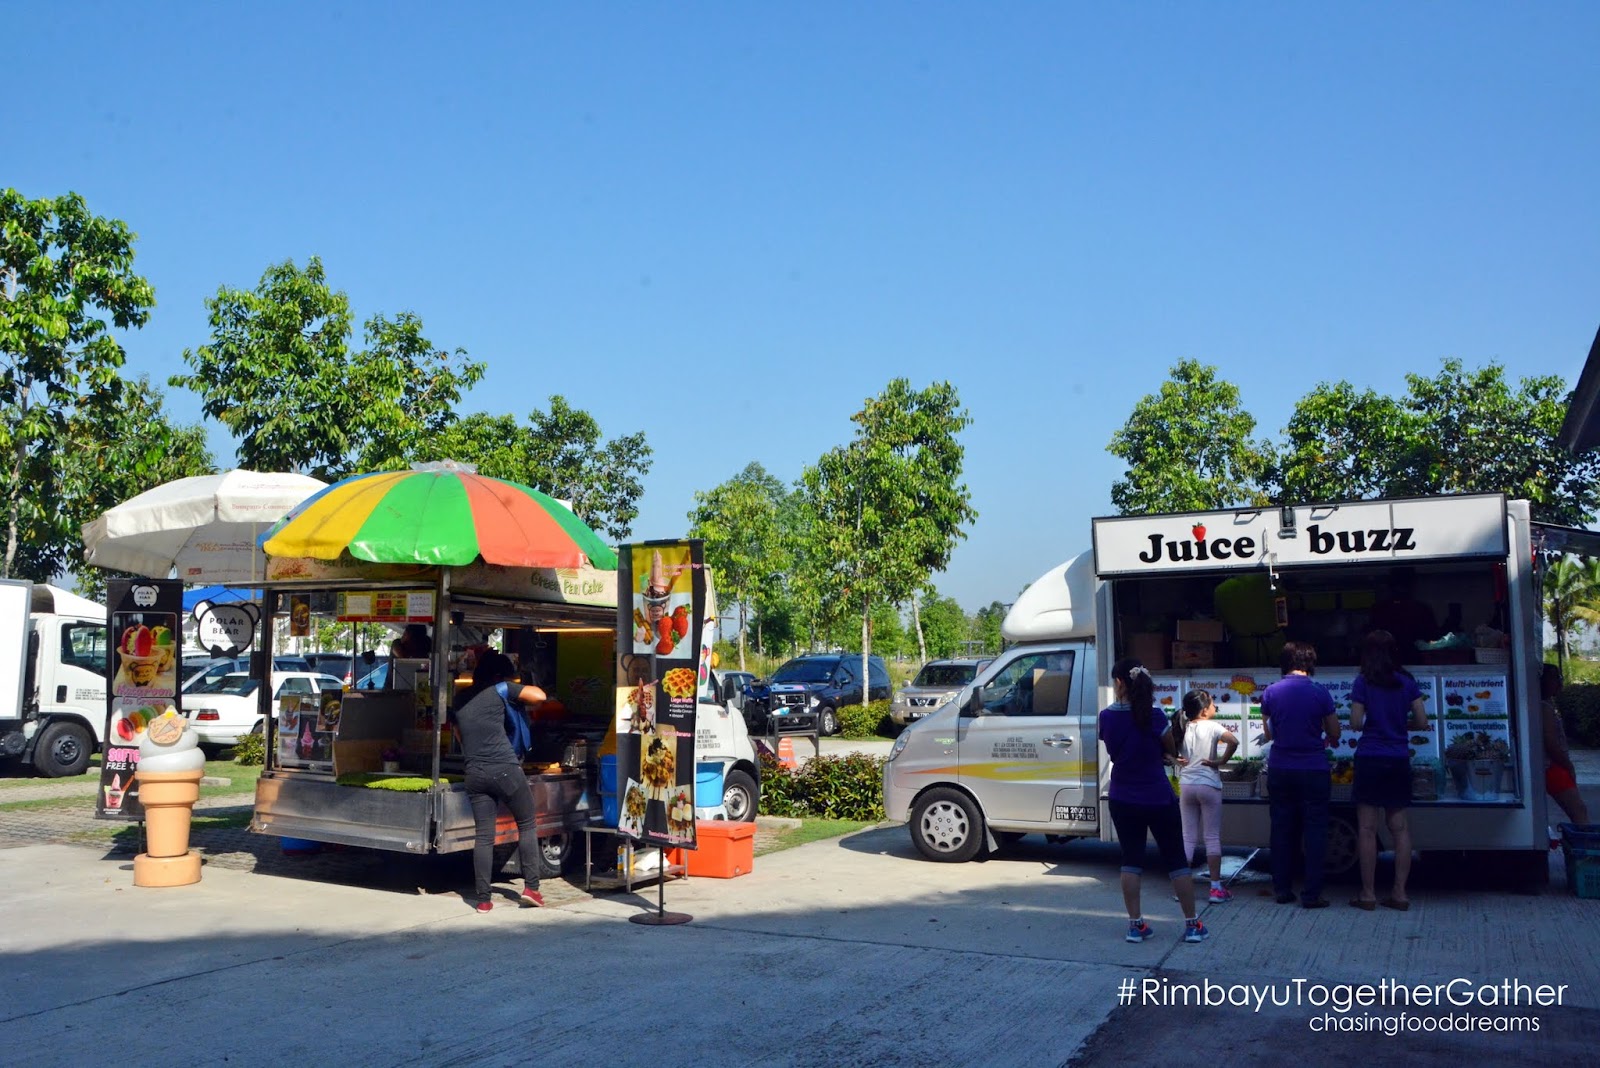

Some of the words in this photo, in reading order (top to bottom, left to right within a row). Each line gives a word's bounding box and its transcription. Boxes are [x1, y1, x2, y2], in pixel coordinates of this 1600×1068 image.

[1139, 528, 1255, 563] Juice
[1306, 524, 1416, 554] buzz
[530, 570, 561, 592] Green
[563, 579, 580, 595] Pan
[582, 579, 604, 595] Cake
[209, 617, 244, 626] POLAR
[212, 627, 240, 635] BEAR
[1189, 681, 1218, 689] Wonder
[1445, 680, 1504, 688] Multi-Nutrient
[1249, 721, 1264, 730] Pur
[1447, 721, 1468, 731] Green
[1469, 721, 1507, 732] Temptation
[106, 762, 127, 771] FREE
